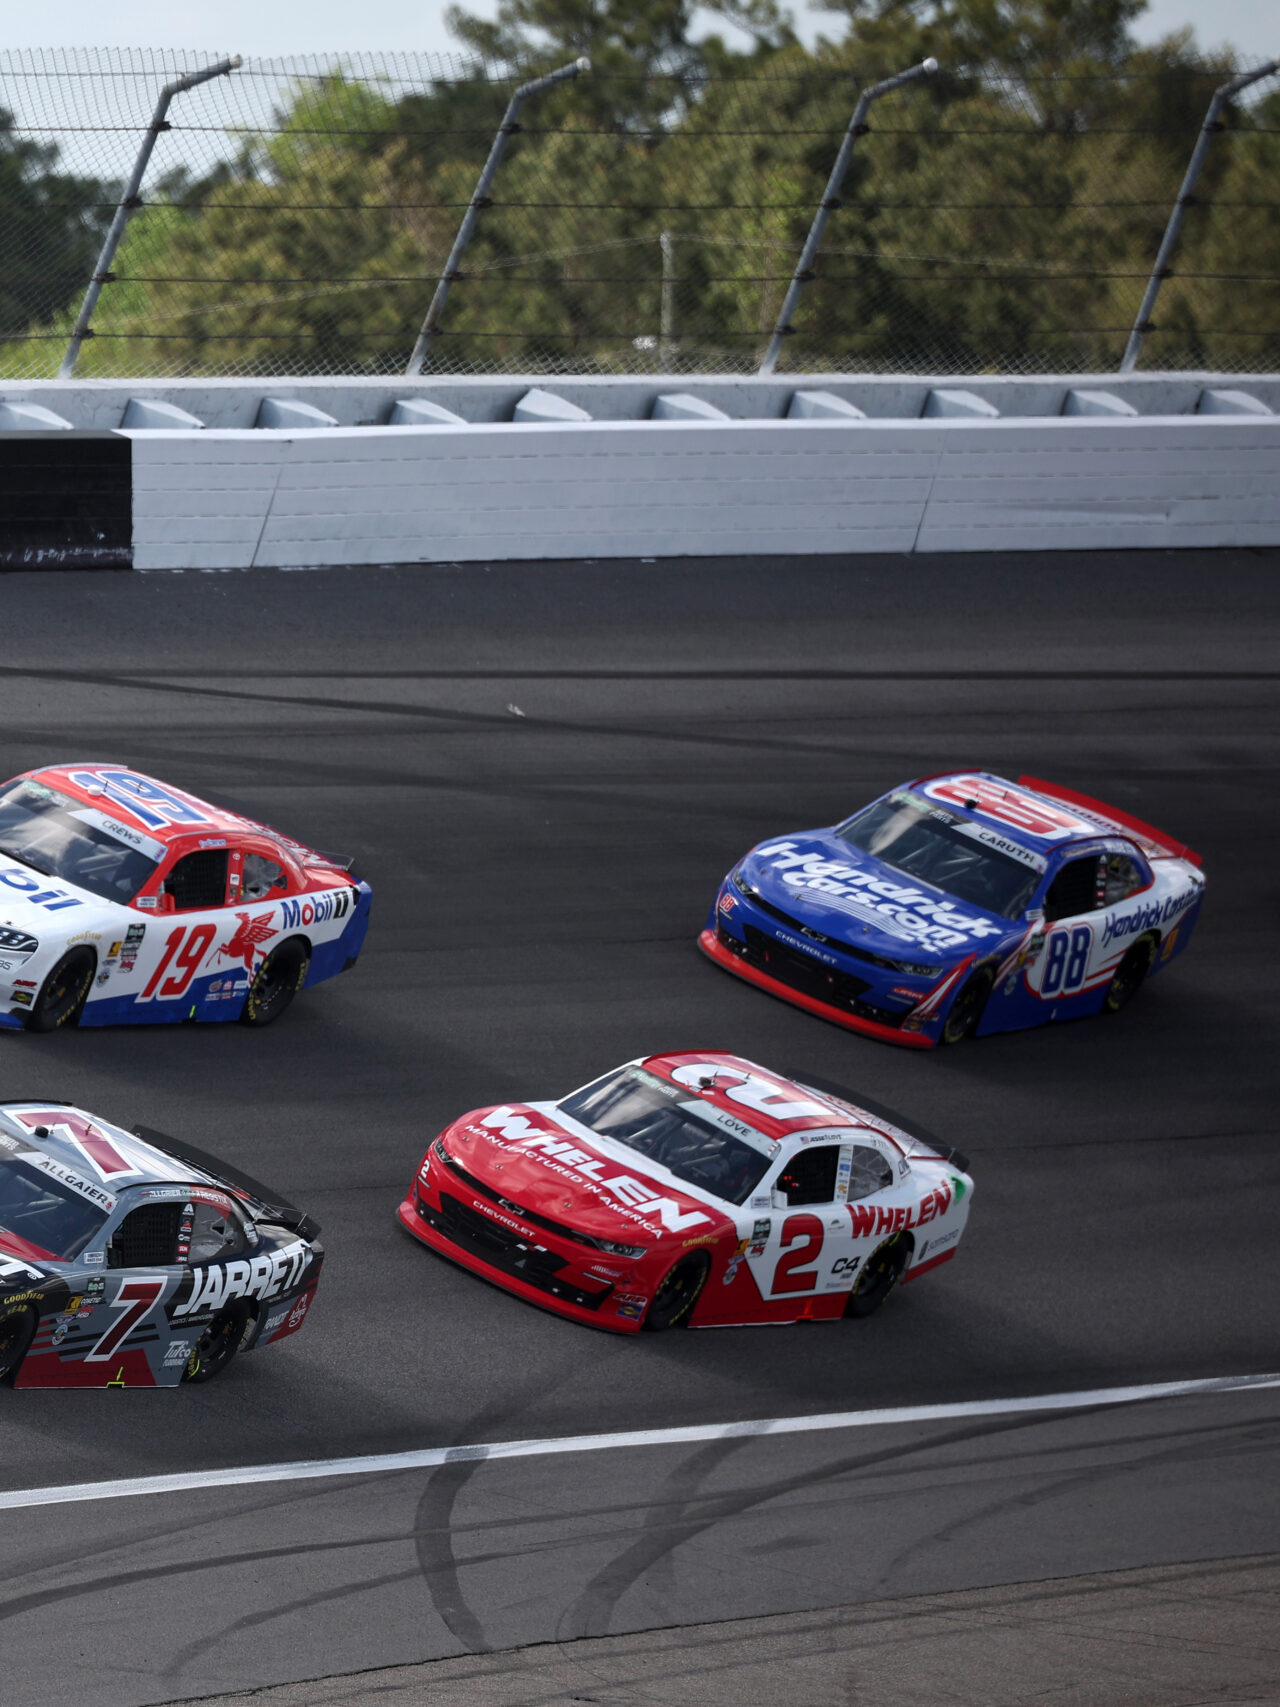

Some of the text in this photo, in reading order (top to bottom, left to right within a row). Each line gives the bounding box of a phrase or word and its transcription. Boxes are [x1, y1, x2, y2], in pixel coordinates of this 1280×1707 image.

[68, 770, 214, 831] 19
[102, 820, 143, 845] CREWS
[978, 832, 1035, 862] CARUTH
[280, 893, 333, 929] Mobil
[720, 893, 734, 912] 88
[753, 841, 1002, 939] Hendrick
[781, 866, 972, 949] Cars.com
[776, 930, 837, 966] CHEVROLET
[1102, 899, 1165, 949] Hendrick
[136, 924, 217, 1000] 19
[1040, 923, 1094, 999] 88
[670, 1062, 838, 1122] 2
[2, 1105, 143, 1182] 7
[717, 1115, 751, 1136] LOVE
[38, 1160, 107, 1204] ALLGAIER
[420, 1159, 431, 1179] 2
[465, 1124, 663, 1239] MANUFACTURED IN AMERICA
[479, 1105, 711, 1234] WHELEN
[473, 1200, 536, 1238] CHEVROLET
[845, 1179, 952, 1239] WHELEN
[172, 1241, 311, 1315] JARRETT
[770, 1213, 825, 1295] 2
[830, 1256, 861, 1274] C4
[3, 1289, 45, 1305] GOODYEAR
[84, 1276, 168, 1362] 7
[163, 1340, 192, 1359] Tufco
